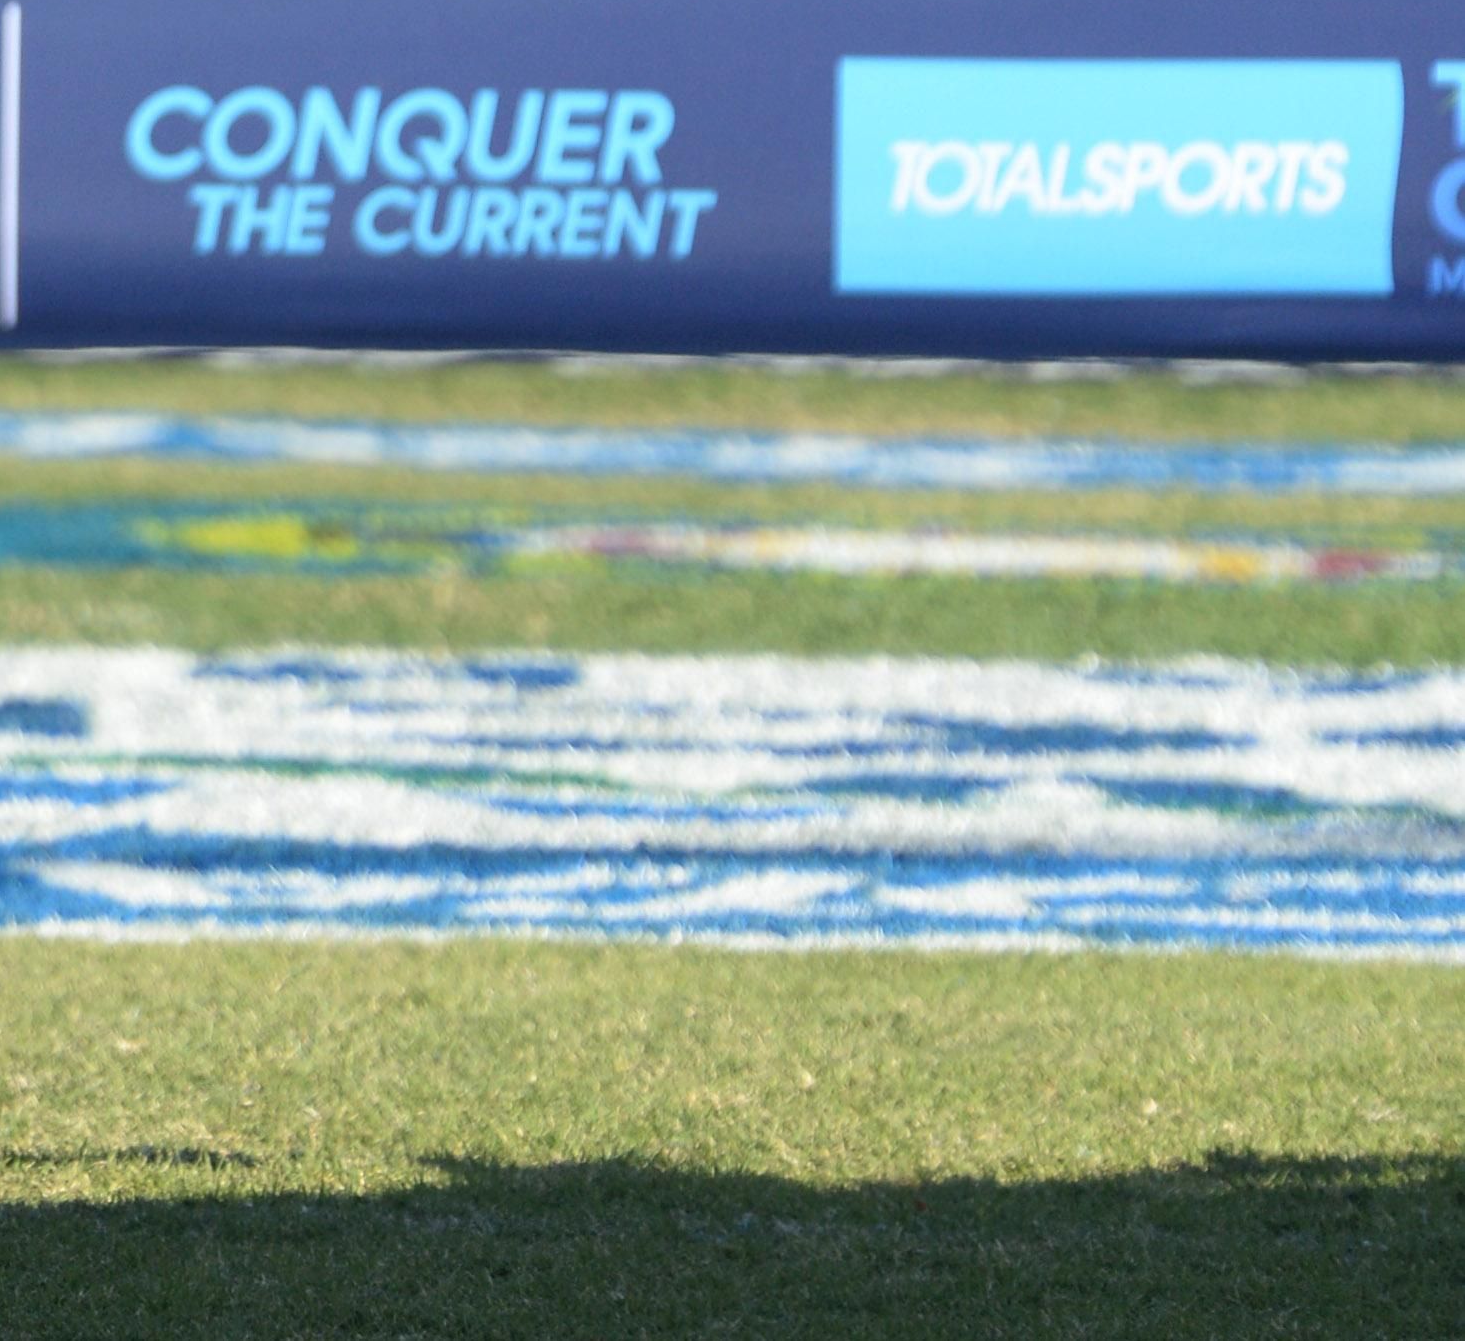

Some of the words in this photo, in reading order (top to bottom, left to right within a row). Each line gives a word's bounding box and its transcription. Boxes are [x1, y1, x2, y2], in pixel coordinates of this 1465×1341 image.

[126, 85, 676, 184] CONQUER
[890, 139, 1349, 215] TOTALSPORTS
[189, 183, 335, 256] THE
[353, 186, 718, 259] CURRENT
